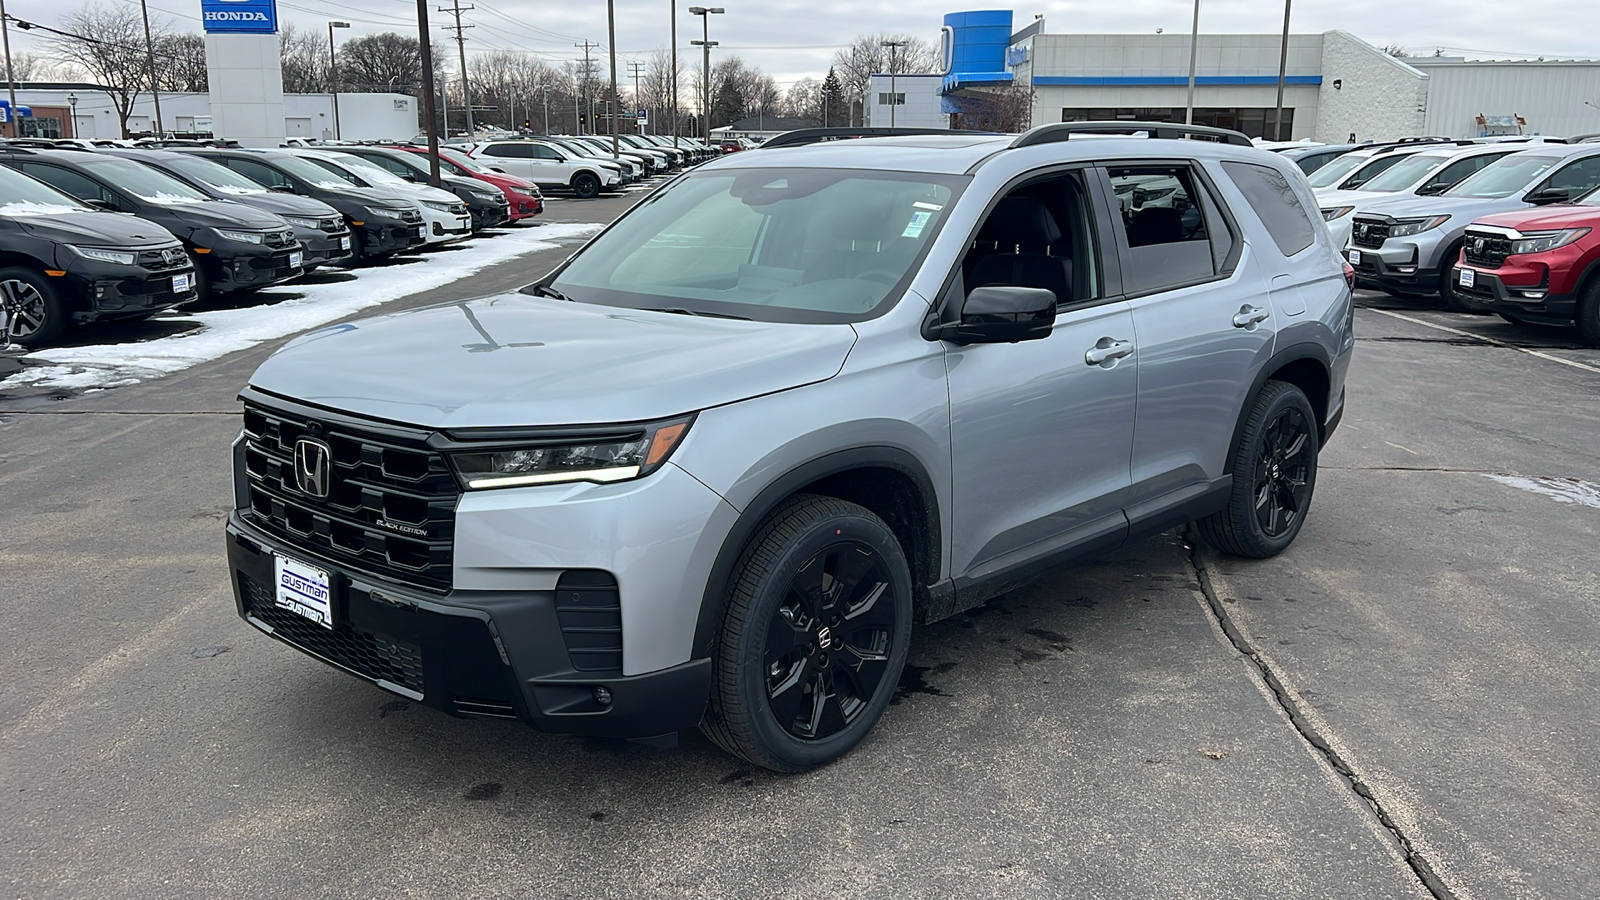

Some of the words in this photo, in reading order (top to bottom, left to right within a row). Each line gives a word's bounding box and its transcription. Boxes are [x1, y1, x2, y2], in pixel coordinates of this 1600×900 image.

[204, 11, 269, 21] HONDA
[376, 519, 398, 530] BLACK
[399, 525, 428, 536] EDITION
